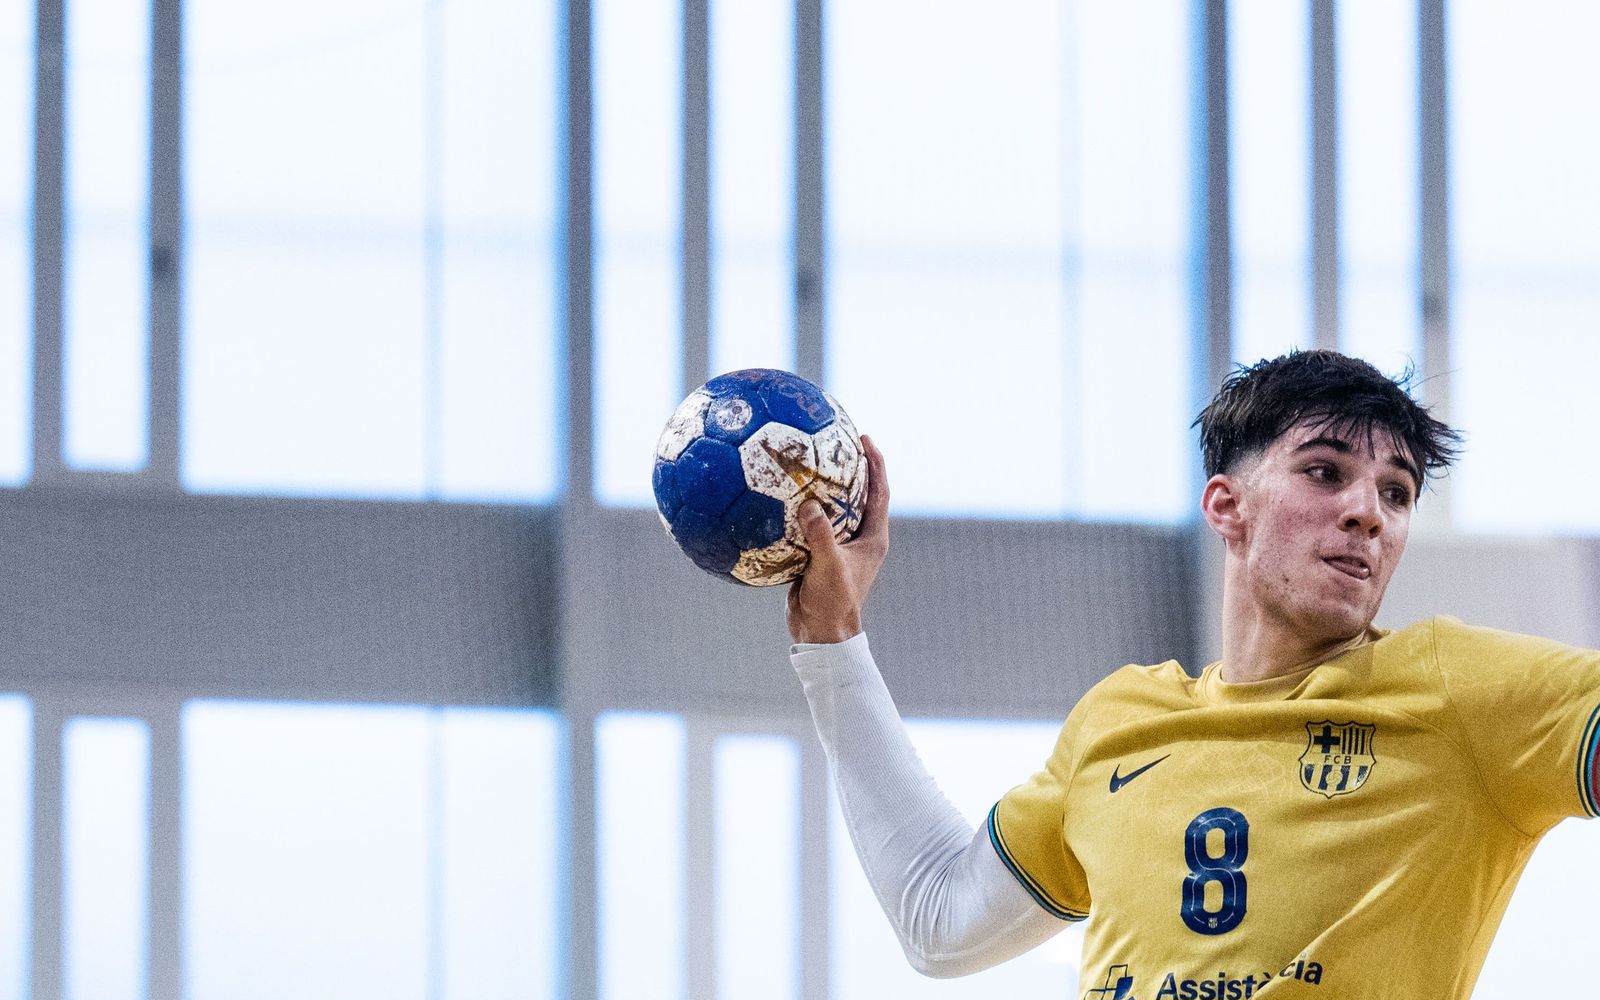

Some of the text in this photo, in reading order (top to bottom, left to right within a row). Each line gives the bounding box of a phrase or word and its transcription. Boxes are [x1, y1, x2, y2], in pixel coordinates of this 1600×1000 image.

[1324, 754, 1352, 765] FCB
[1180, 806, 1250, 936] 8
[1156, 953, 1324, 1000] Assistcia
